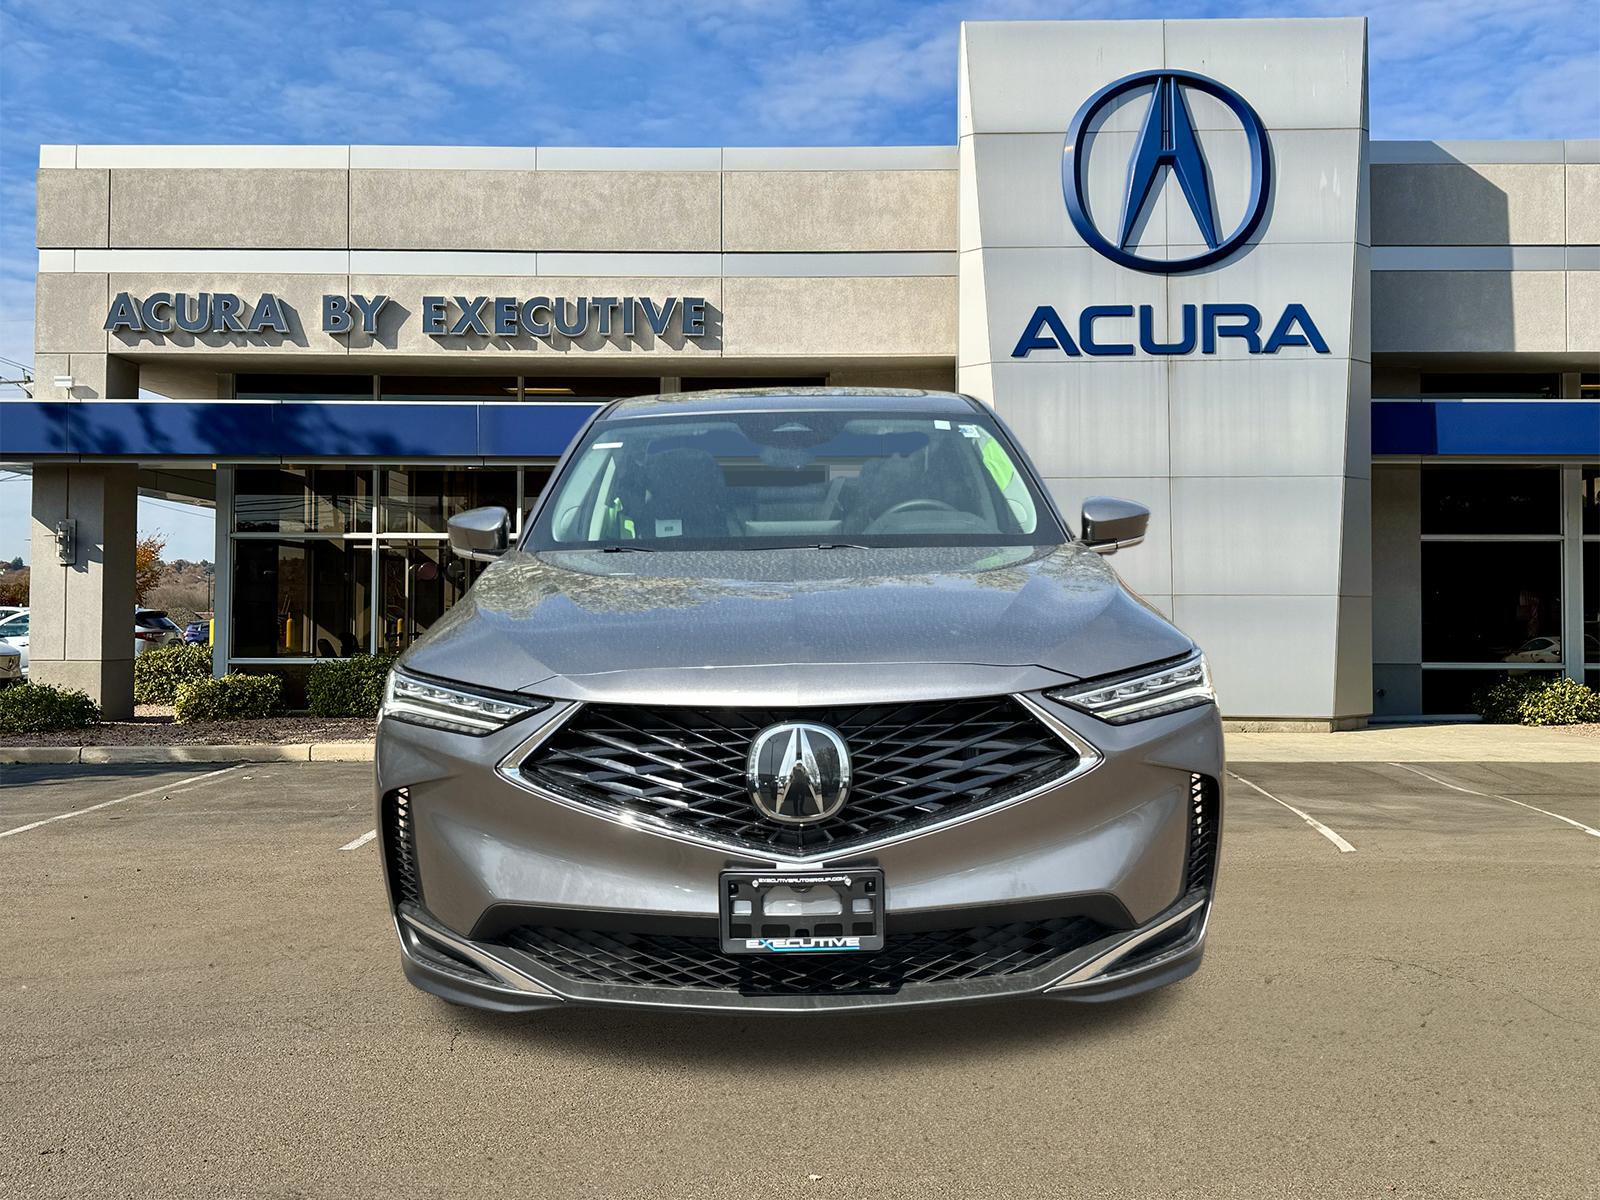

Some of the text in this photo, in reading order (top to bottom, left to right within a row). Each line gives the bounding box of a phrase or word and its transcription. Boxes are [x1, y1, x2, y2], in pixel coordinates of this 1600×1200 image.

[104, 292, 706, 337] ACURA BY EXECUTIVE
[1011, 303, 1331, 357] ACURA
[746, 938, 860, 950] EXECUTIVE
